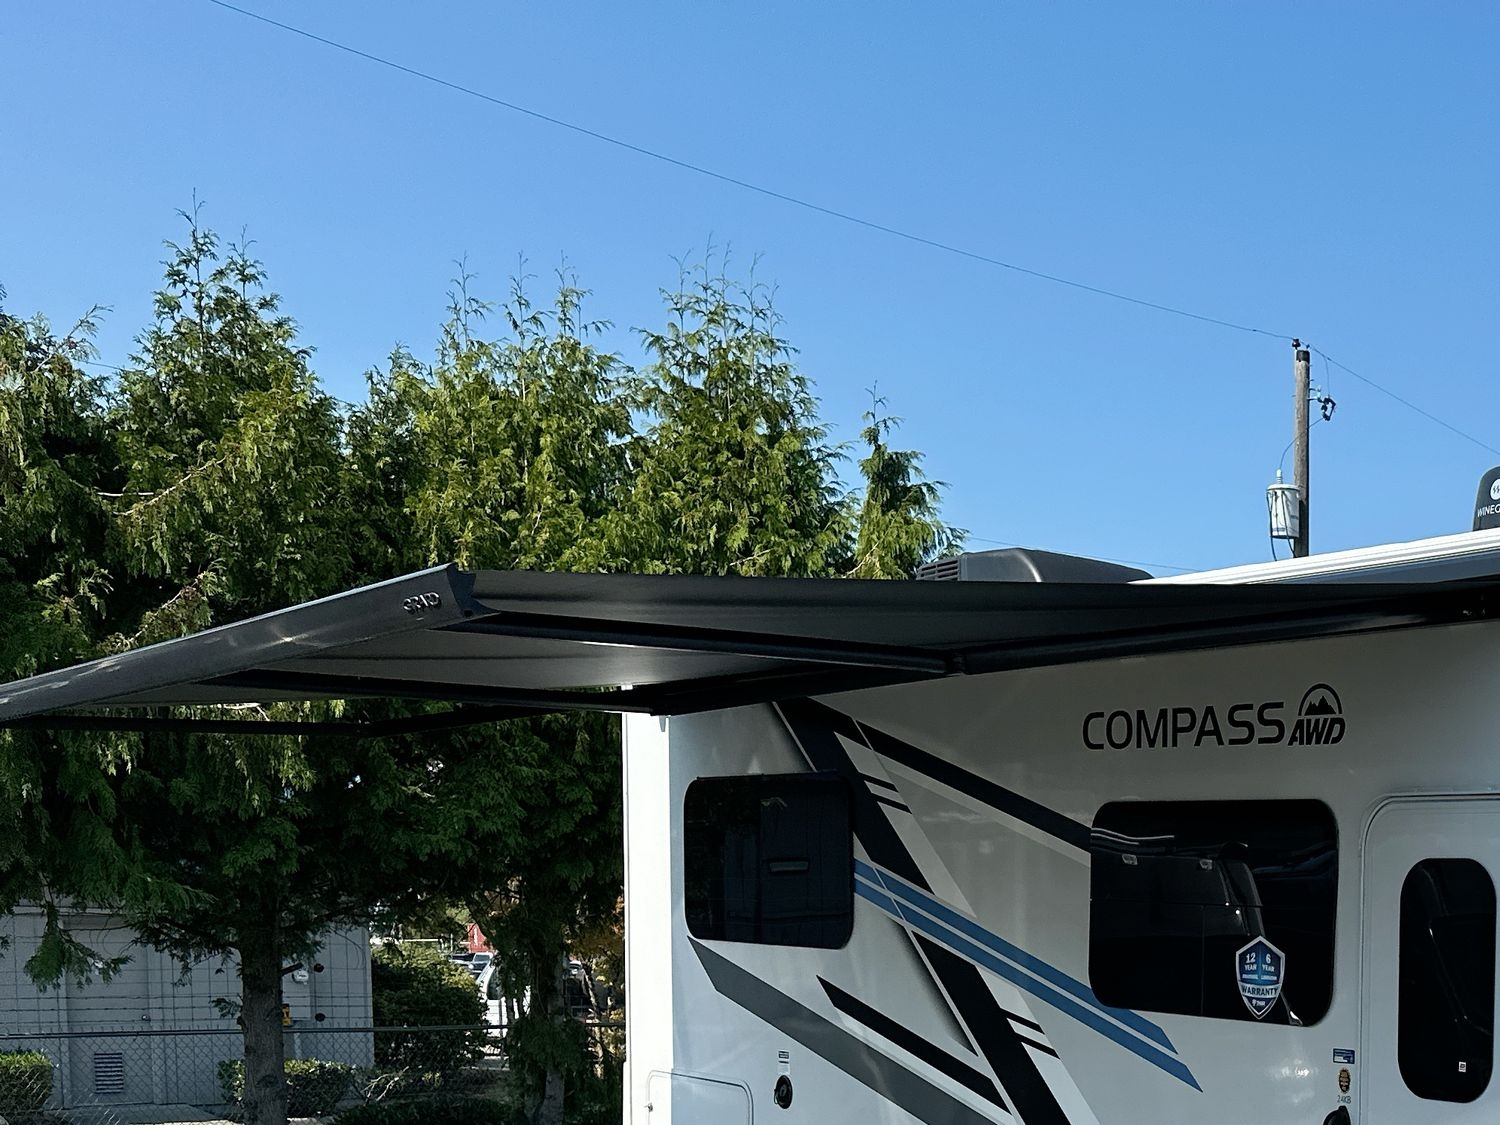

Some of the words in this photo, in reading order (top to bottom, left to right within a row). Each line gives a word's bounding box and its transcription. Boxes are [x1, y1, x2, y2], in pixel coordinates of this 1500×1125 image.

[1082, 701, 1286, 750] COMPASS
[1287, 716, 1346, 747] AWD
[1245, 952, 1256, 964] 12
[1265, 953, 1272, 964] 6
[1262, 964, 1275, 972] YEAR
[1242, 985, 1278, 997] WARRANTY
